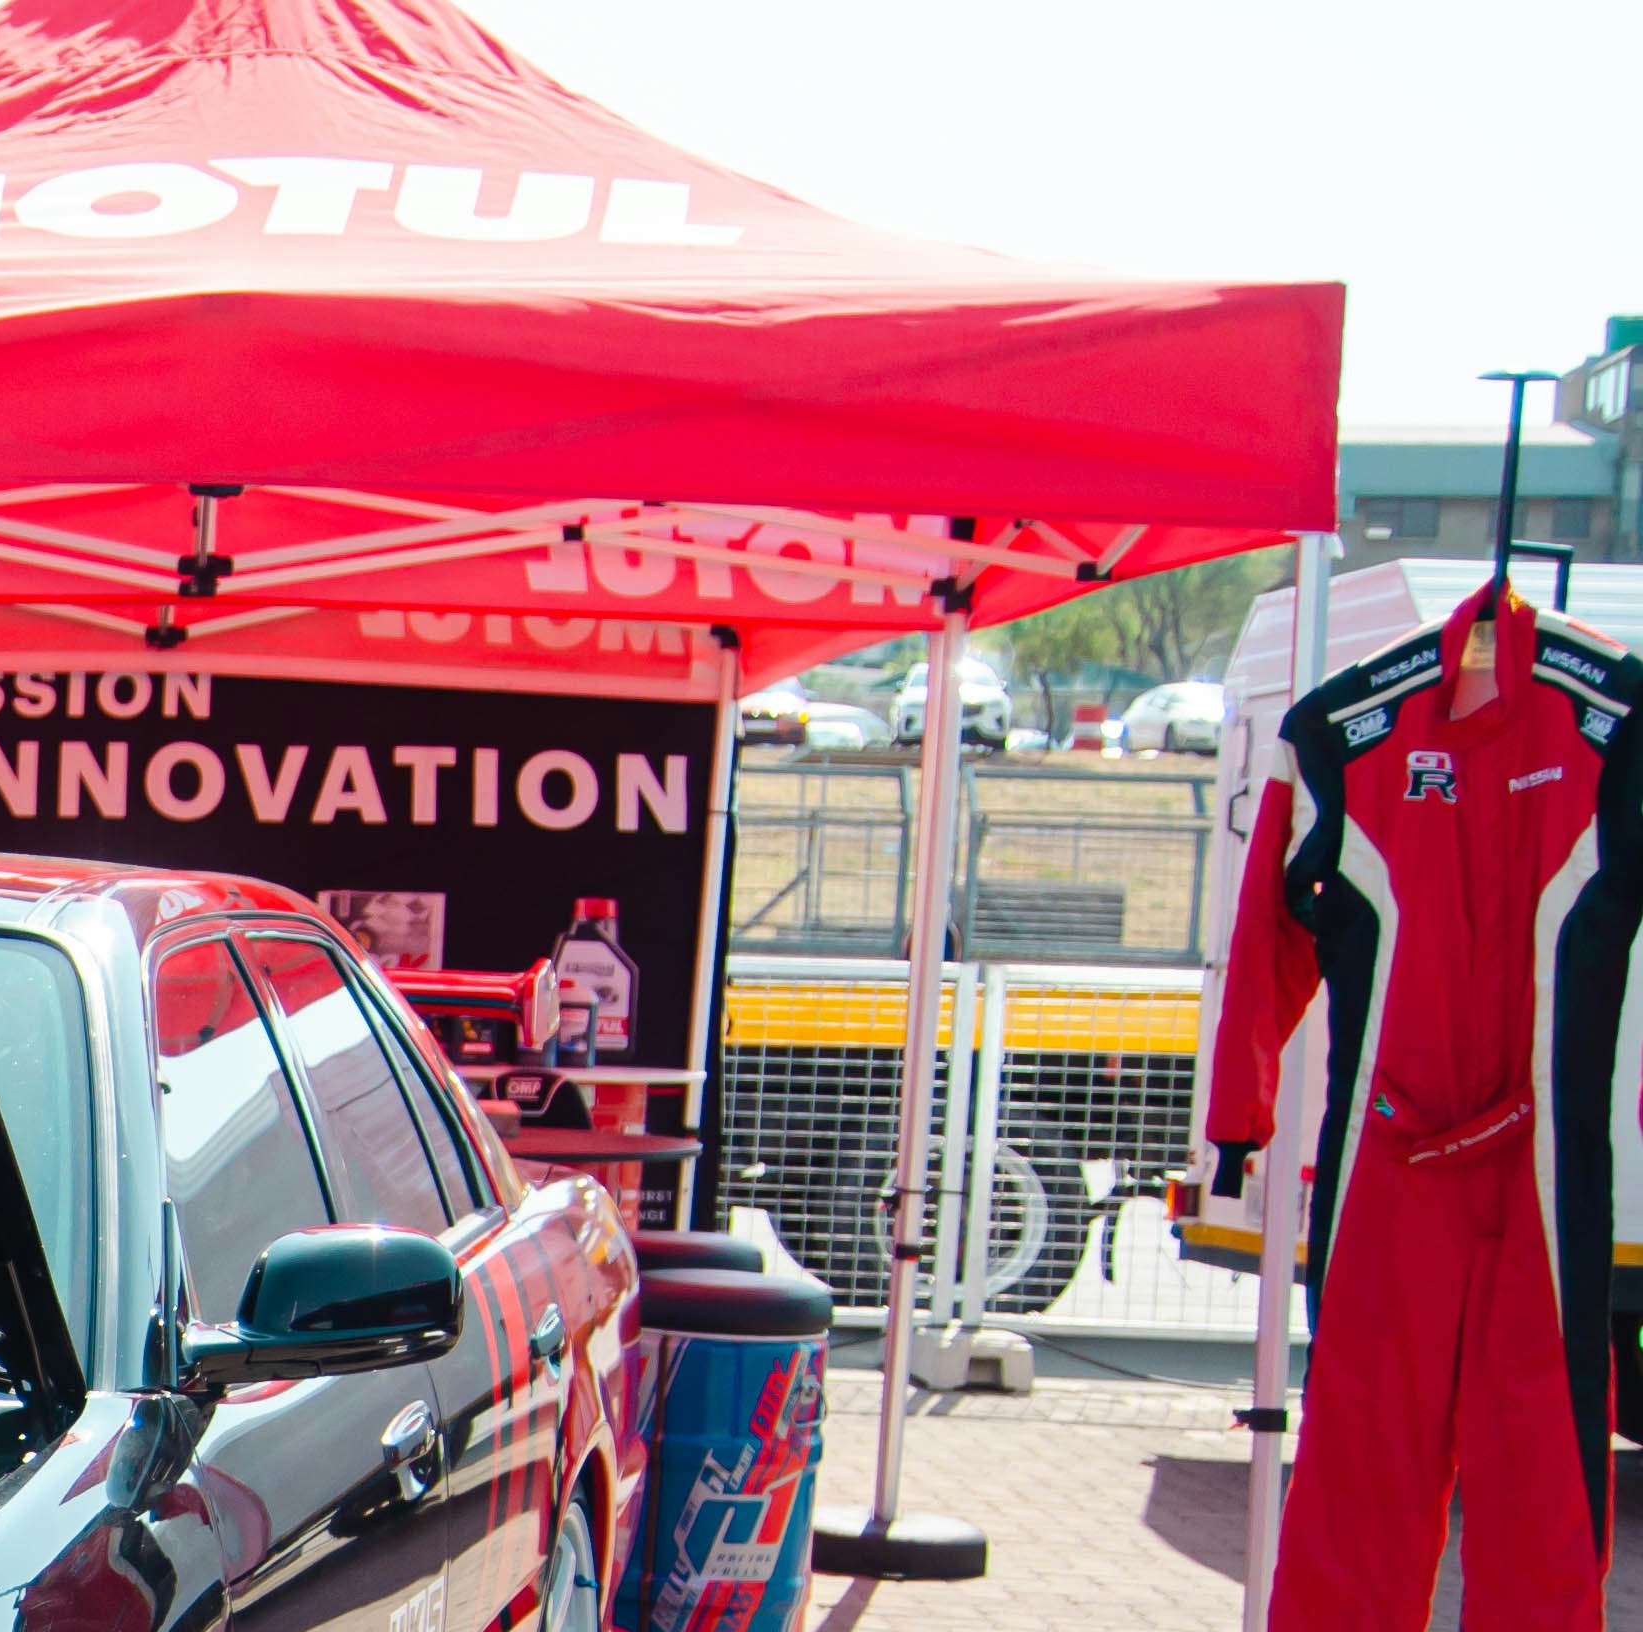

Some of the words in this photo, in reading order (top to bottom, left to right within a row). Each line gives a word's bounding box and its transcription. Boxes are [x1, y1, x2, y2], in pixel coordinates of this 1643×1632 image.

[1370, 648, 1438, 687] NISSAN
[1541, 646, 1607, 684] NISSAN
[1344, 709, 1388, 742] OMP
